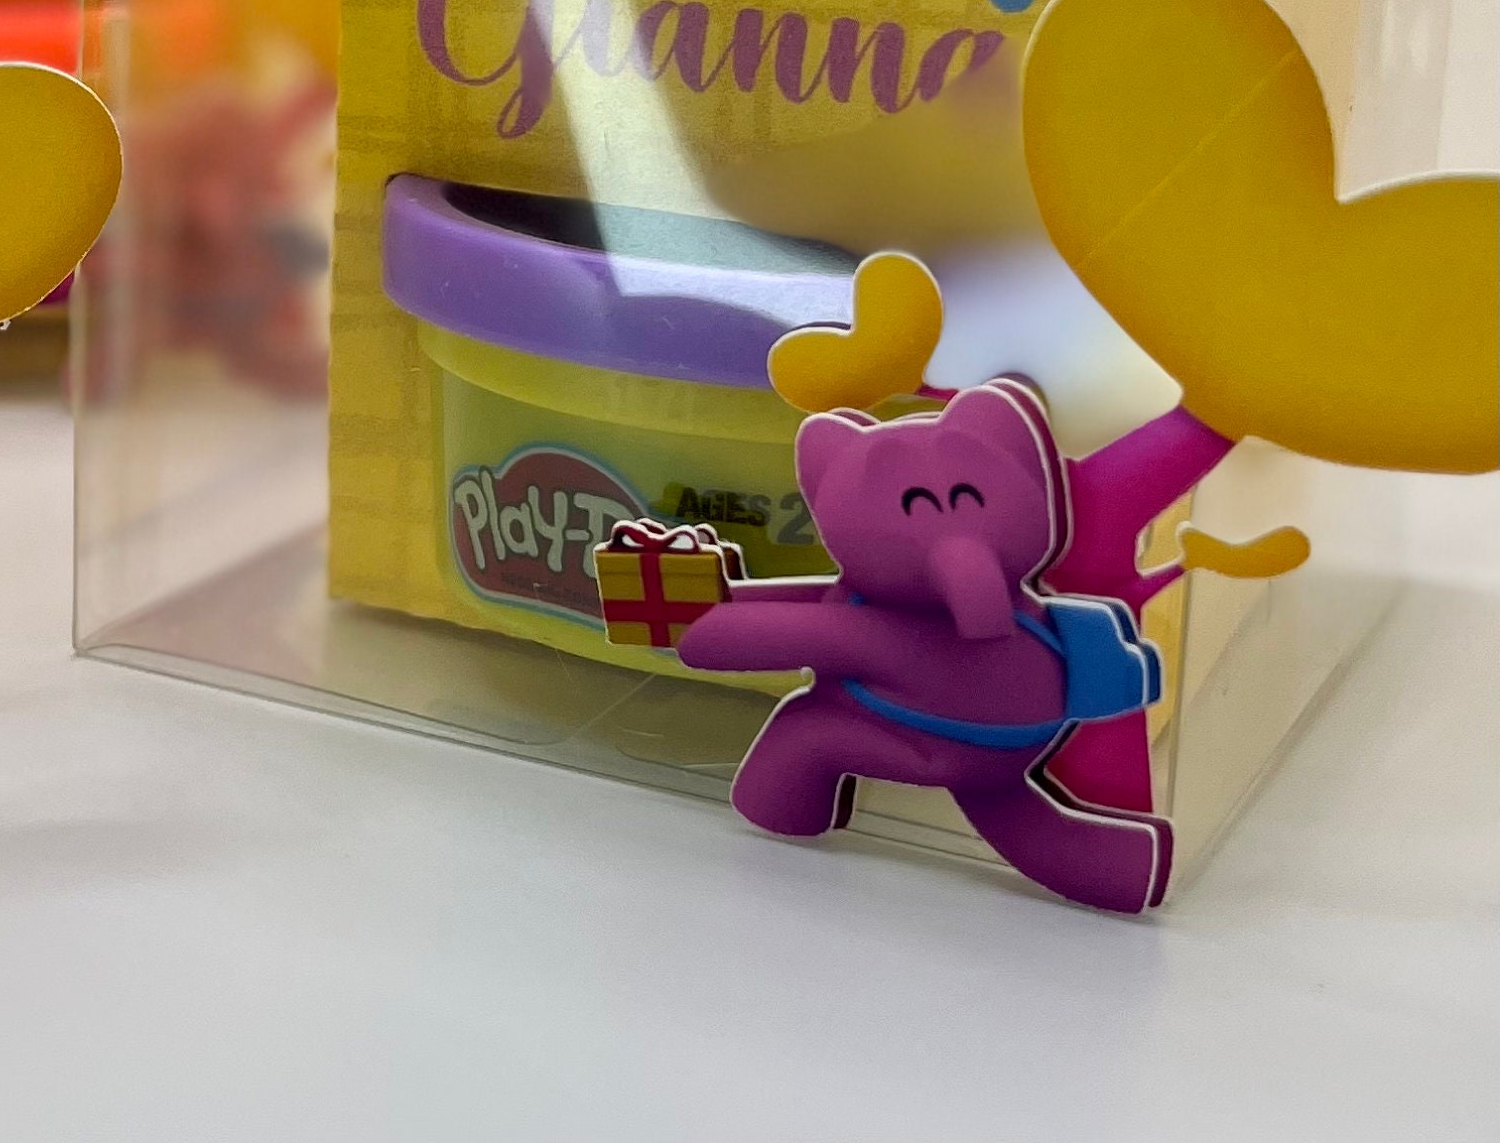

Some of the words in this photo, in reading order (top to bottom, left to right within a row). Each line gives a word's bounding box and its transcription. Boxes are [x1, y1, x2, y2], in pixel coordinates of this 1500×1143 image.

[454, 468, 635, 578] Play-D
[675, 487, 771, 526] AGES
[777, 492, 814, 544] 2
